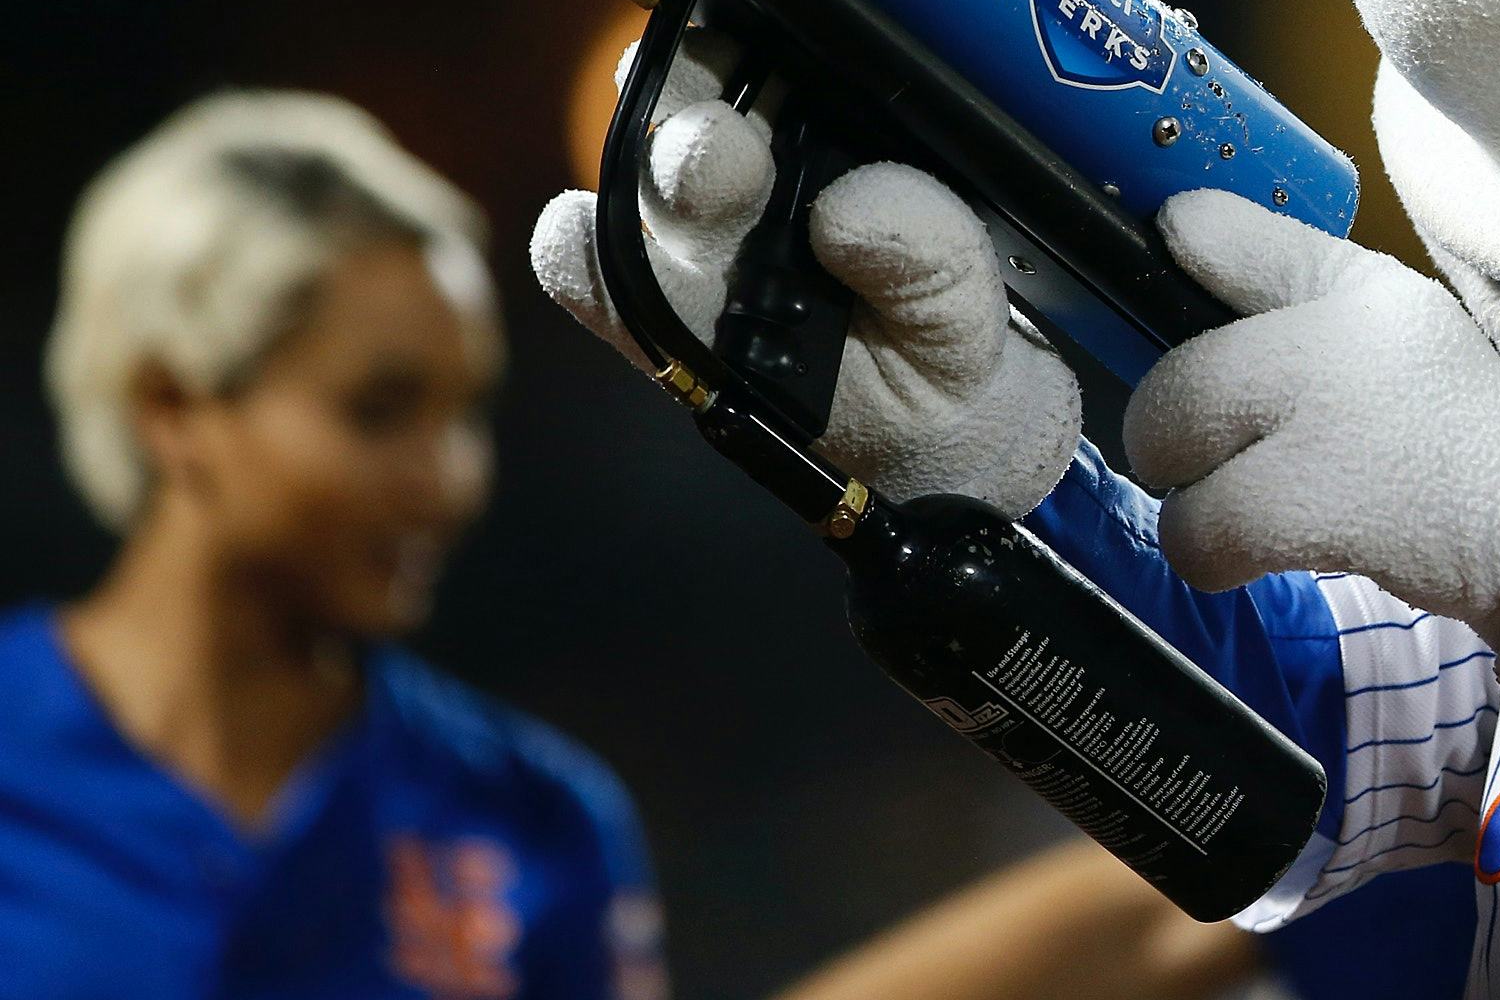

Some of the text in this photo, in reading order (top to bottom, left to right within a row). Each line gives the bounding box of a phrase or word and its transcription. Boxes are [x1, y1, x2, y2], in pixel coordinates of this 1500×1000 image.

[986, 629, 1030, 677] Use and Storage:
[1004, 636, 1049, 690] equipment rated for
[1011, 660, 1021, 671] use
[1020, 647, 1032, 661] with
[1010, 661, 1042, 695] the specified
[1043, 670, 1060, 691] expose
[1058, 659, 1069, 671] this
[1069, 678, 1076, 686] or
[1075, 666, 1085, 679] any
[1018, 680, 1038, 700] cylinder
[1033, 692, 1054, 713] cylinder
[1052, 685, 1060, 693] to
[1047, 682, 1083, 723] other source of
[1079, 698, 1096, 719] expose
[1094, 687, 1105, 699] this
[1069, 713, 1096, 741] cylinder to
[1075, 711, 1109, 746] temperatures
[1113, 732, 1125, 745] alter
[1123, 721, 1133, 732] the
[1083, 732, 1101, 752] greater
[1103, 746, 1124, 767] cylinder
[1123, 739, 1129, 747] or
[1128, 724, 1142, 740] valve
[1117, 728, 1160, 778] caustic strippers or
[1110, 749, 1133, 773] corrosive
[1142, 770, 1152, 781] not
[1151, 757, 1163, 771] drop
[1162, 777, 1172, 788] out
[1171, 769, 1178, 778] of
[1176, 754, 1190, 771] reach
[1139, 774, 1160, 795] cylinder
[1178, 770, 1203, 798] breathing
[1221, 785, 1238, 809] cylinder
[1154, 800, 1161, 808] of
[1170, 799, 1190, 820] cylinder
[1199, 792, 1210, 805] well
[1185, 804, 1211, 831] ventilated
[1201, 834, 1211, 844] can
[1210, 819, 1225, 835] cause
